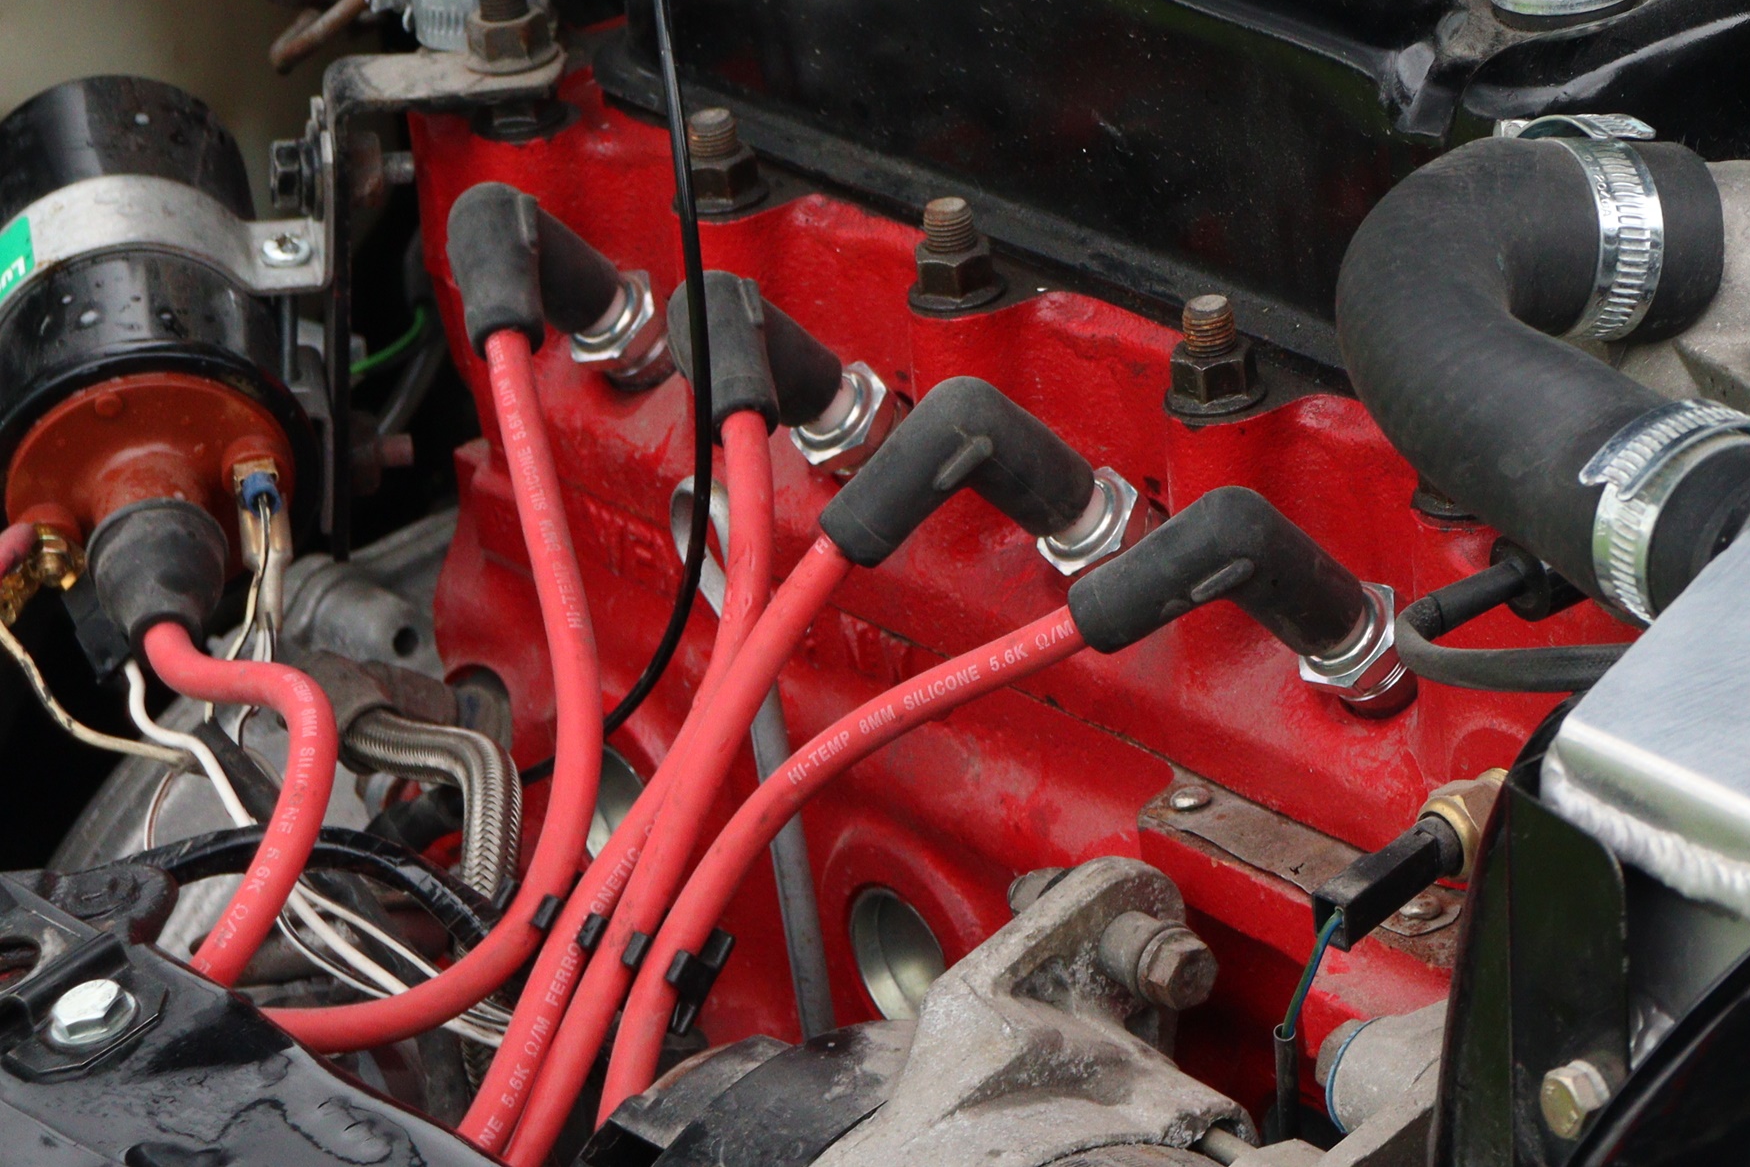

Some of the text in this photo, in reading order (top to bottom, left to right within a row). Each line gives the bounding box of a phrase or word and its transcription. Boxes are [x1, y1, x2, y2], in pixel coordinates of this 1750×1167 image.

[506, 412, 528, 442] 5.6K
[517, 445, 548, 512] SILICONE
[539, 519, 562, 555] 8MM
[553, 562, 584, 629] HI-TEMP
[300, 703, 319, 738] 8MM
[787, 620, 1076, 785] HI-TEMP 8MM SILICONE 5.6K Ω/M
[276, 745, 316, 835] SILICONE
[246, 846, 282, 896] 5.6K
[501, 1063, 531, 1109] 5.6K
[523, 1016, 551, 1059] Ω/M
[545, 846, 642, 1009] FERROGNETIC
